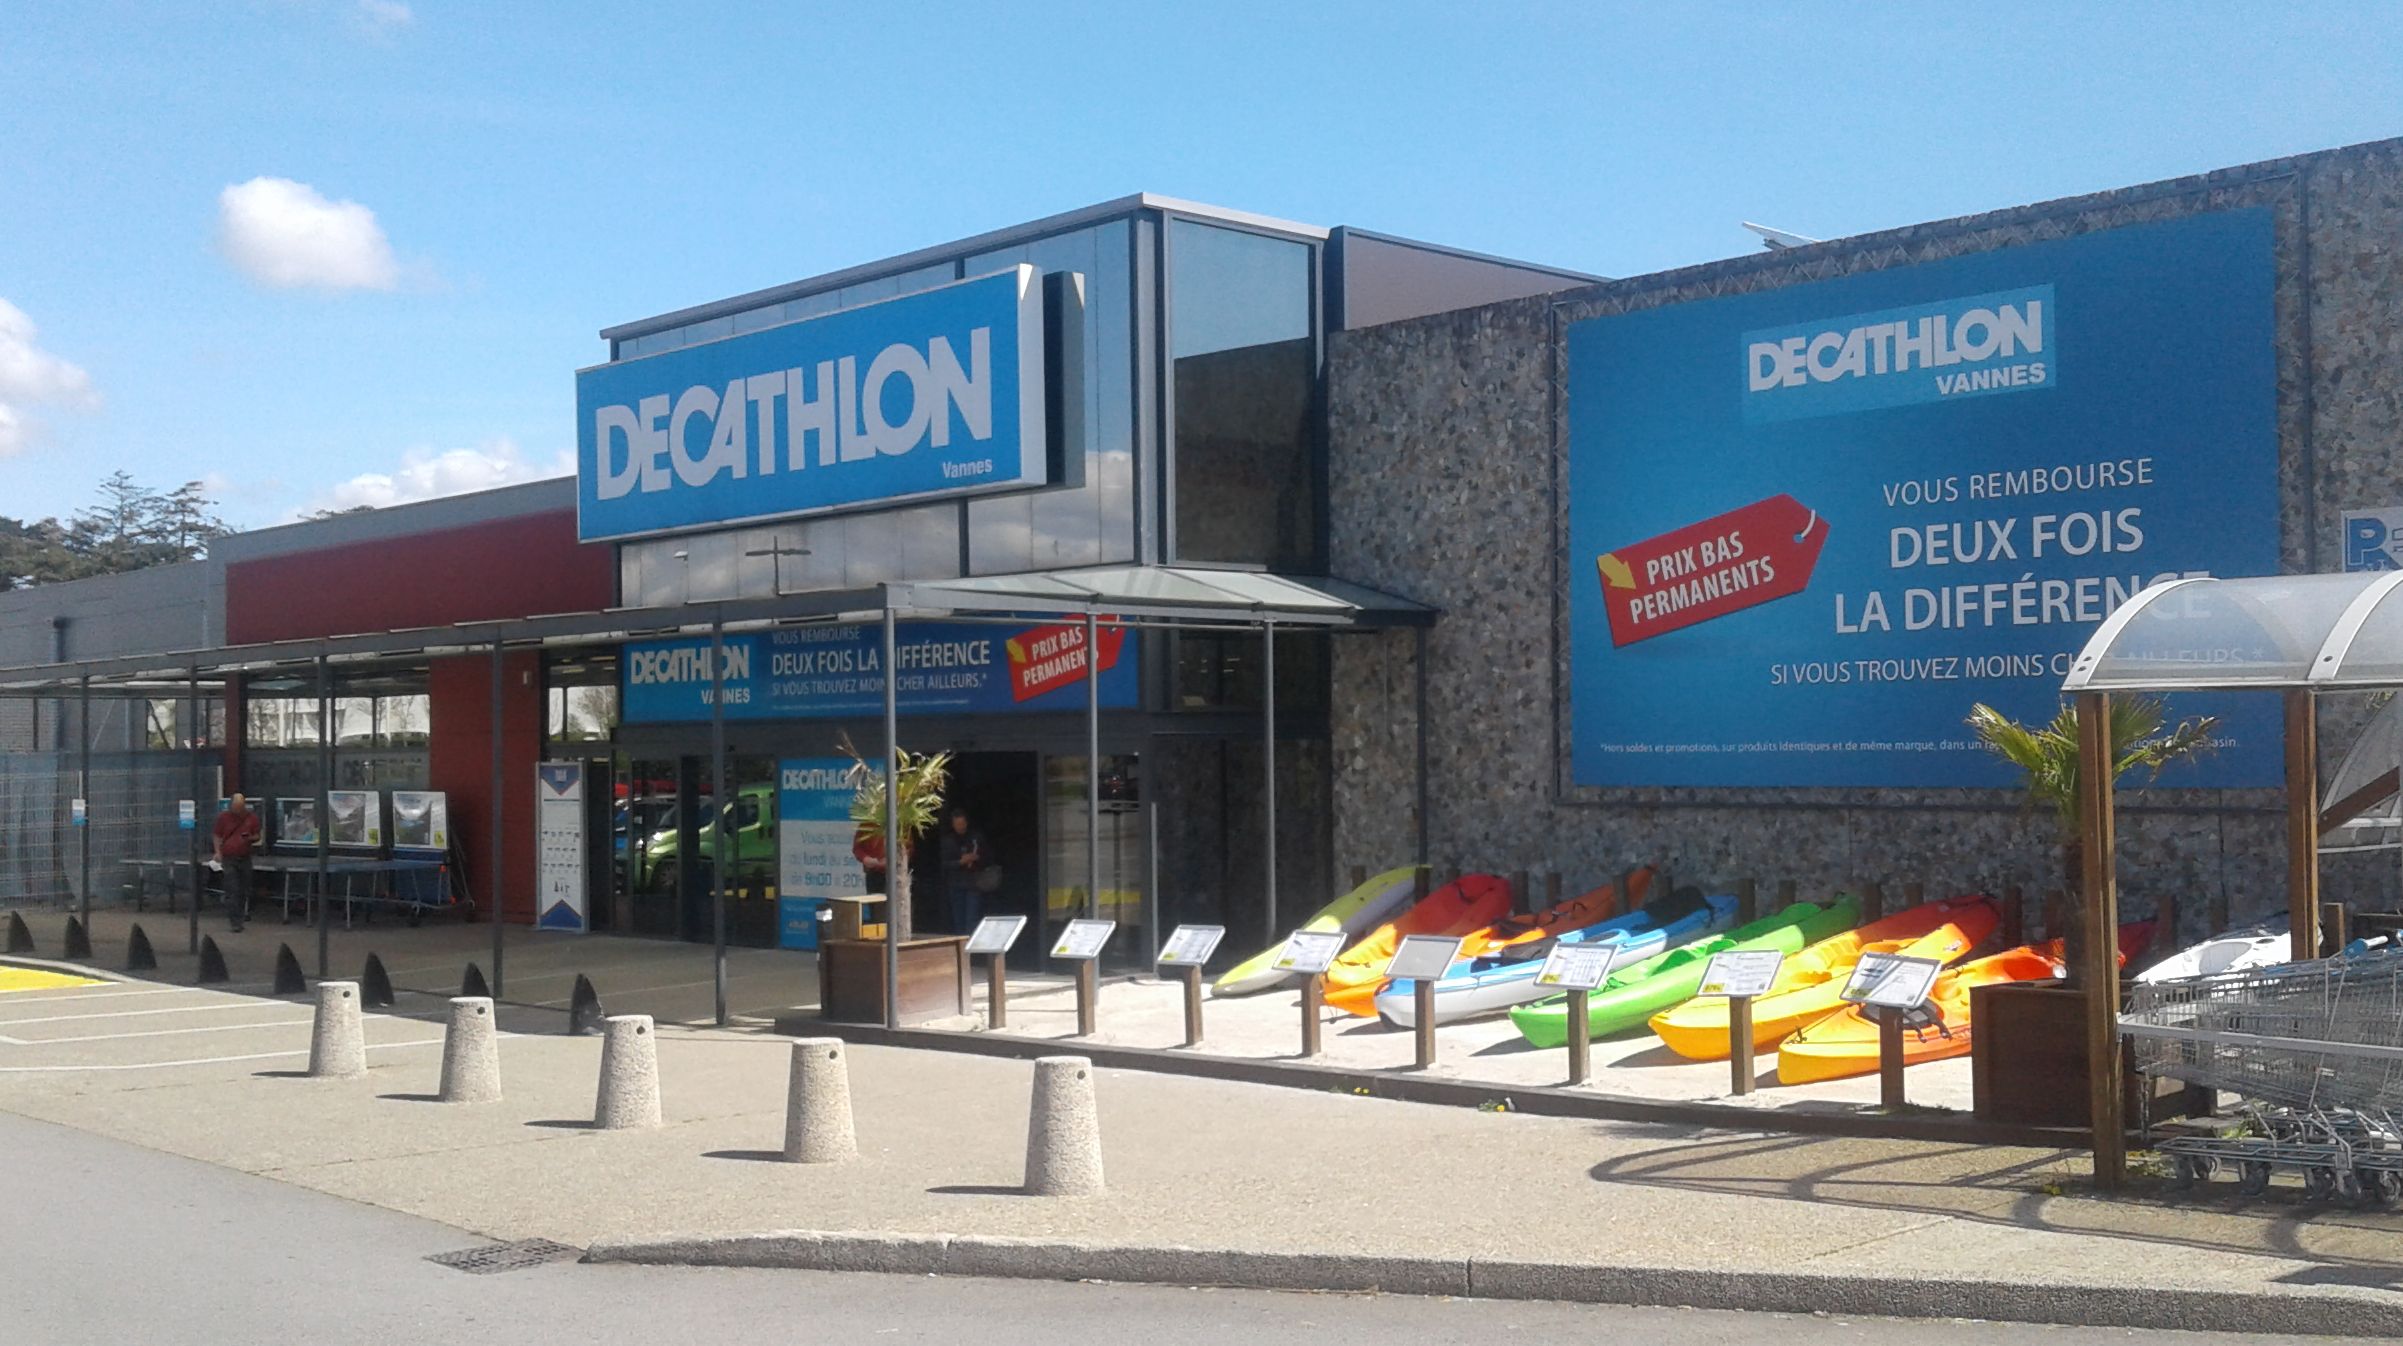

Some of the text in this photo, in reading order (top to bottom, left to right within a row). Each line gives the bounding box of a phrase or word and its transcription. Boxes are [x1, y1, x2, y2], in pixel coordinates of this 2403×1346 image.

[1748, 300, 2042, 393] DECATHLON
[1936, 362, 2047, 395] VANNES
[596, 326, 993, 500] DECATHLON
[942, 457, 993, 479] Vannes
[1882, 457, 2154, 507] VOUS REMBOURSE
[1890, 507, 2144, 569] DEUX FOIS
[1646, 531, 1744, 586] PRIX BAS
[1629, 555, 1776, 625] PERMANENTS
[1835, 590, 1891, 634] LA
[772, 625, 861, 645] VOUS REMBOURSE
[1031, 626, 1084, 662] PRIX BAS
[772, 639, 991, 677] DEUX FOIS LA IFFÉRENCE
[1770, 663, 1788, 685] SI
[1791, 661, 1851, 683] VOUS
[1855, 657, 1959, 681] TROUVEZ
[1965, 653, 2044, 678] MOINS
[772, 683, 782, 697] SI
[782, 682, 809, 696] VOUS
[811, 679, 857, 695] TROUVEZ
[859, 677, 886, 693] MOIN
[896, 675, 925, 691] CHER
[1738, 740, 1777, 754] produits
[1845, 741, 1858, 750] de
[1939, 739, 1965, 750] dans
[1967, 741, 1981, 750] un
